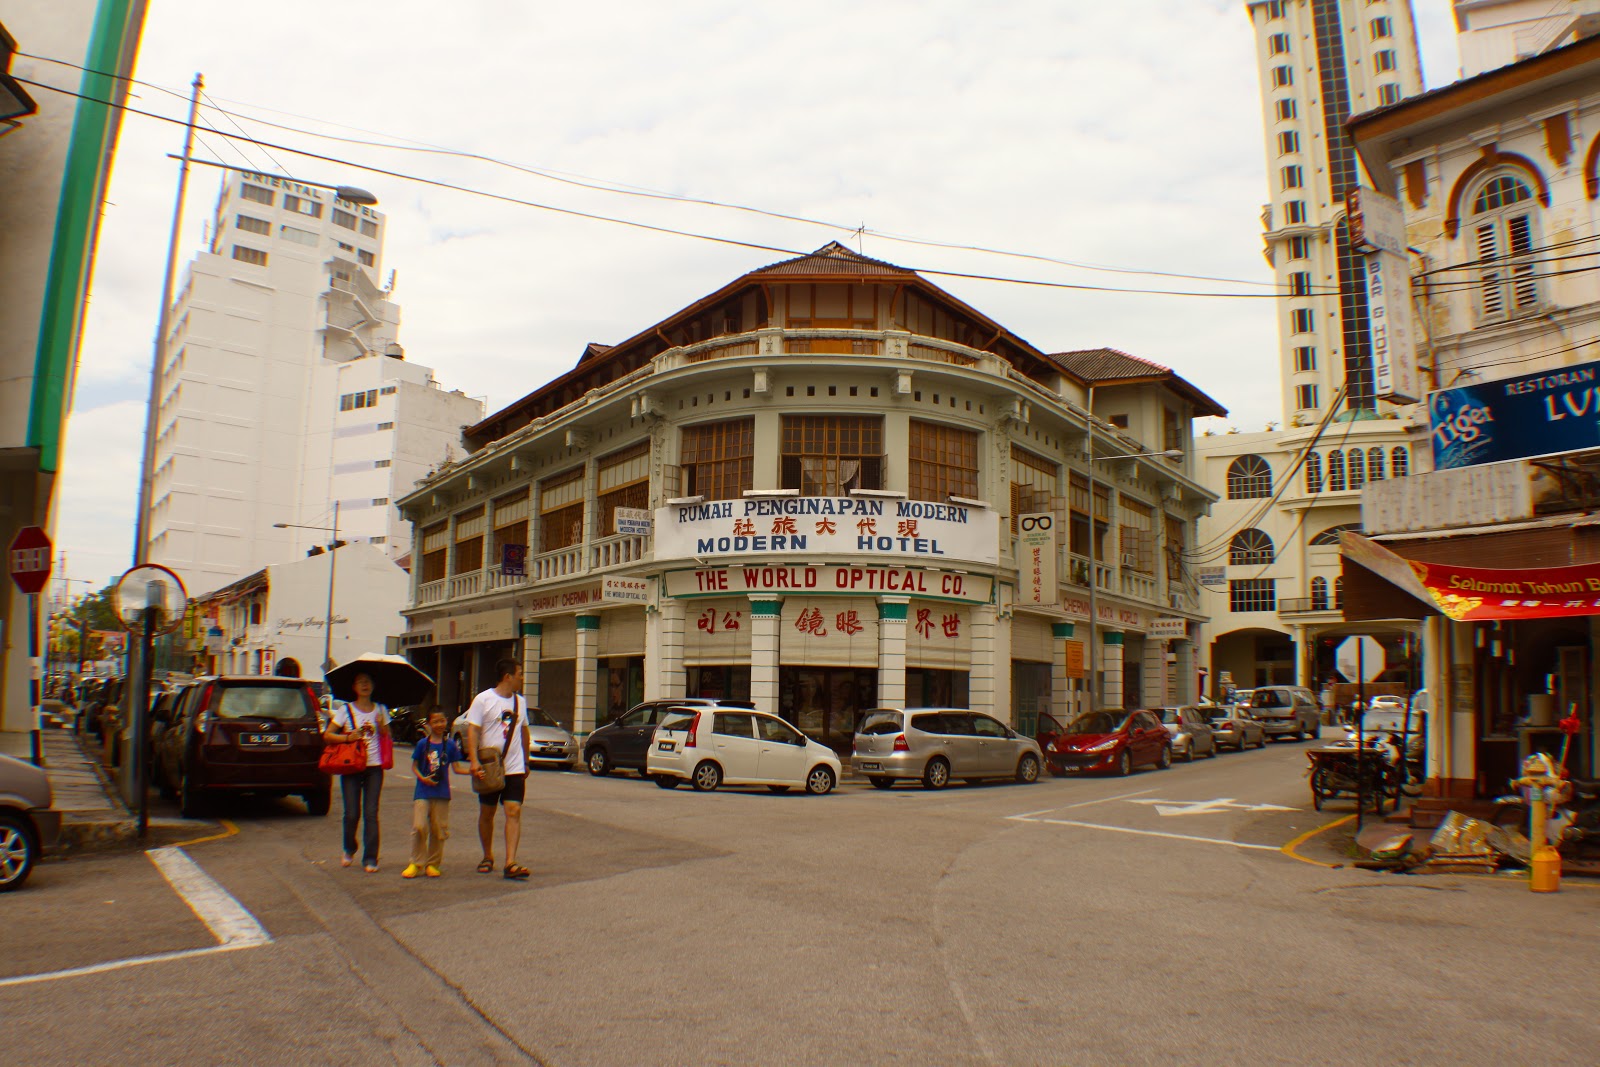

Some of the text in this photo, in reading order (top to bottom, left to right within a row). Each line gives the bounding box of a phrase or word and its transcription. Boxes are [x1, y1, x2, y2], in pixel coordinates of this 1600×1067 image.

[241, 171, 379, 219] ORIENTAL HOTEL
[1369, 261, 1382, 298] BAR
[1374, 324, 1391, 390] HOTEL
[1504, 367, 1595, 396] RESTORAN
[1432, 403, 1495, 449] Tiger
[679, 498, 968, 523] RUMAH PENGINAPAN MODERN
[697, 535, 944, 554] MODERN HOTEL
[695, 568, 967, 595] THE WORLD OPTICAL CO.
[1448, 574, 1524, 594] Selamat
[1522, 581, 1584, 594] Tahun
[562, 589, 588, 606] CHERMIN
[626, 592, 640, 600] OPTICAL
